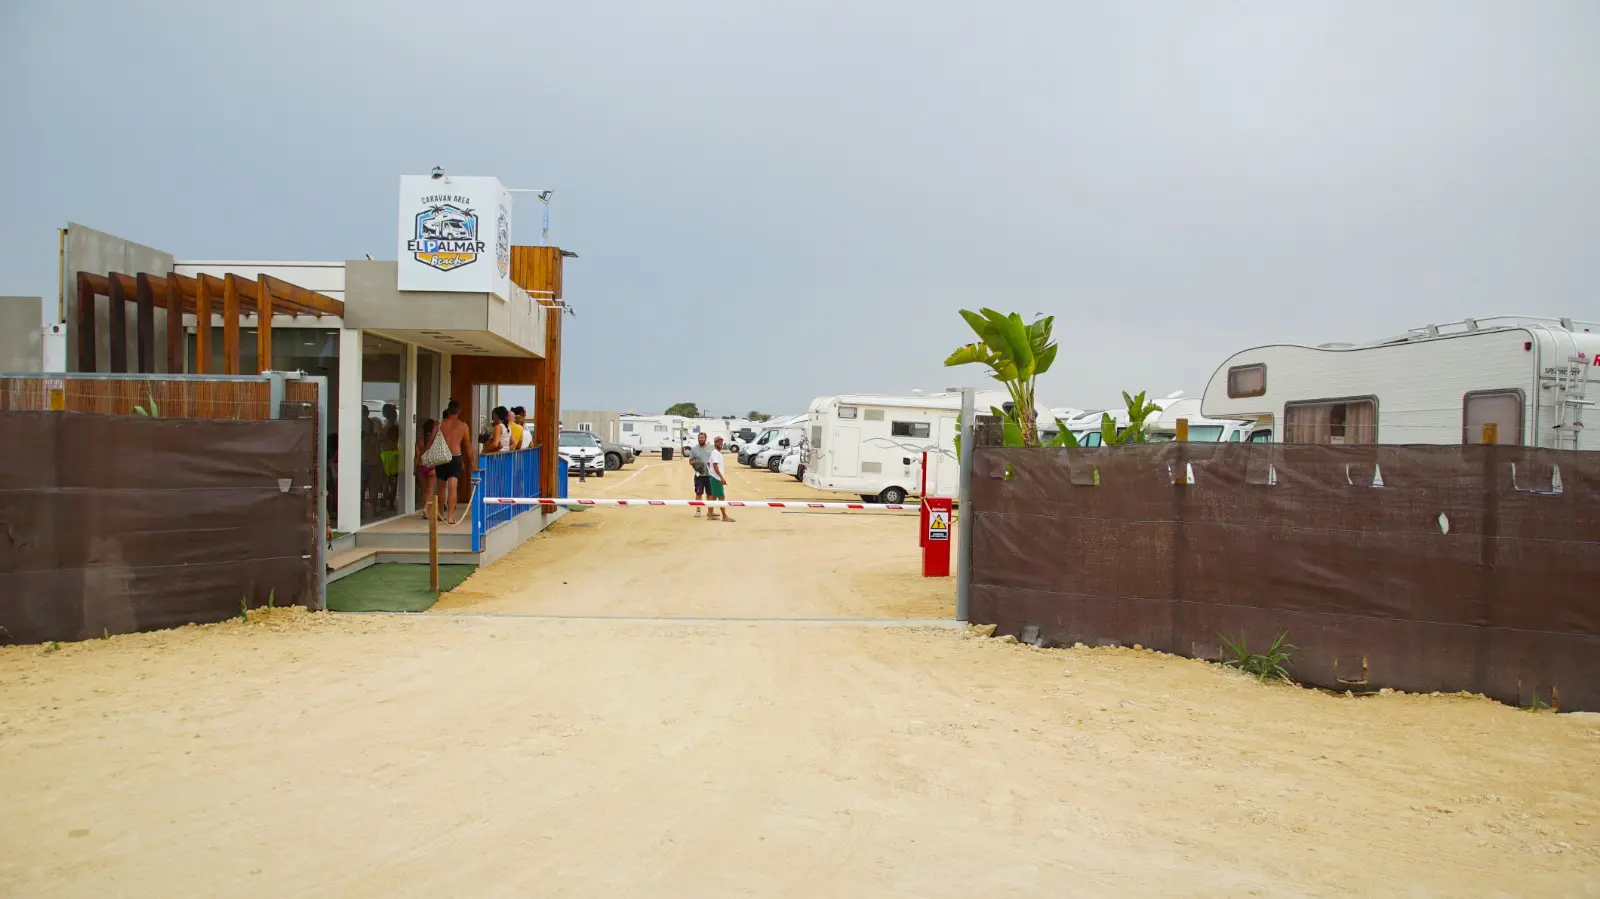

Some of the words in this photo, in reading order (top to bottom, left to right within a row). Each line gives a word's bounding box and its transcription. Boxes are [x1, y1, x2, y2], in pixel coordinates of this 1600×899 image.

[422, 194, 452, 204] CARAVAN
[453, 195, 470, 205] AREA
[407, 240, 423, 251] EL
[426, 241, 485, 253] PALMAR
[430, 254, 466, 266] Beach
